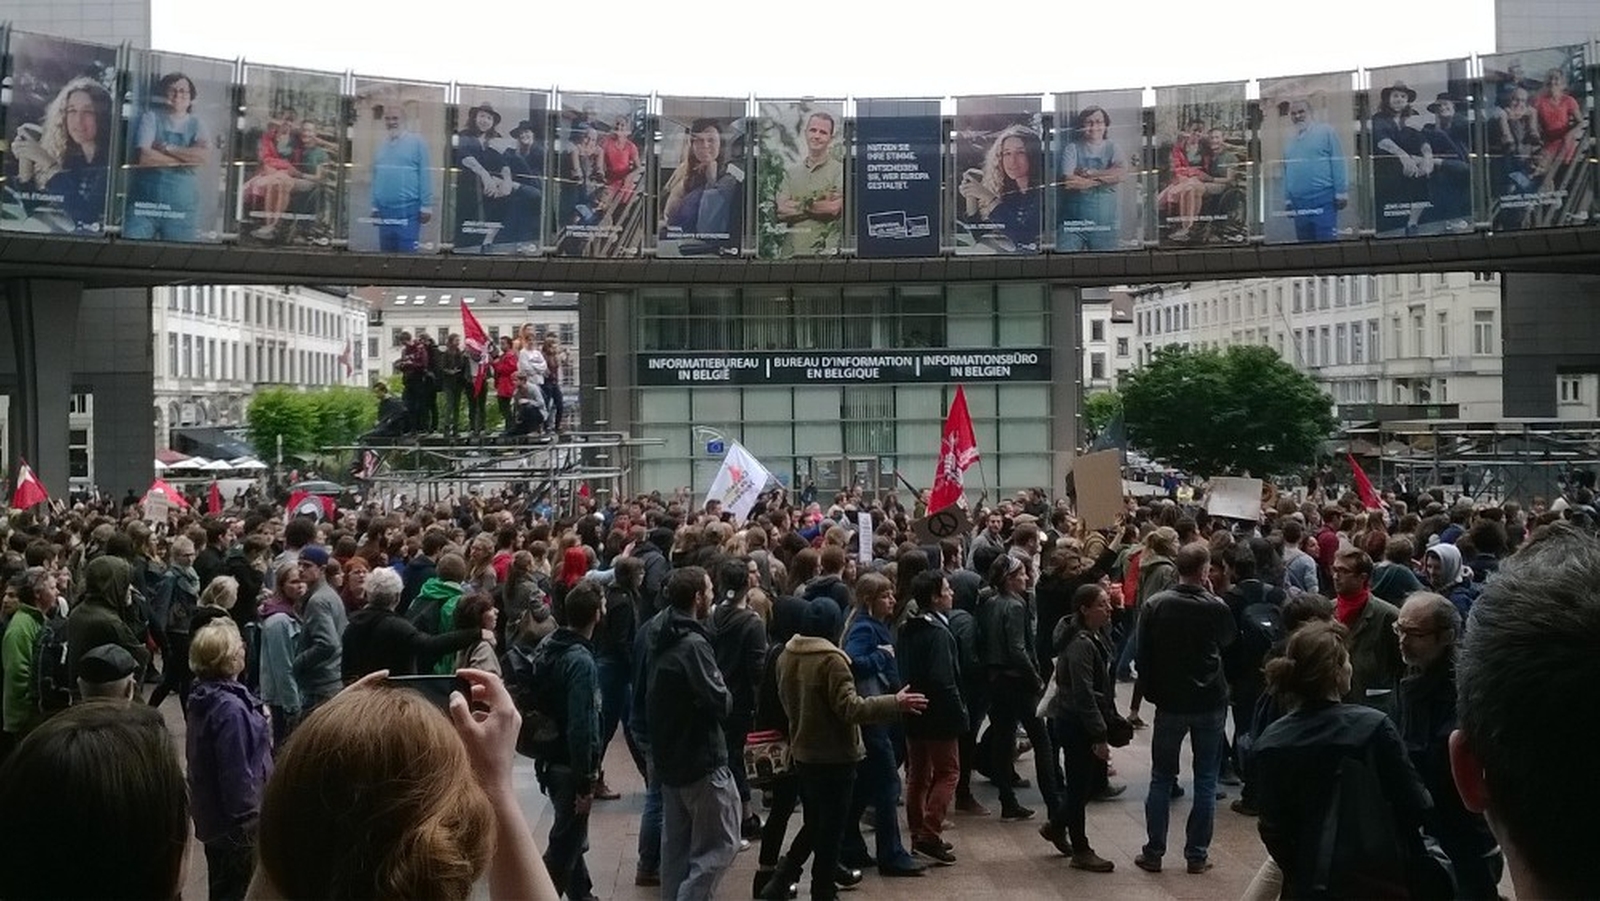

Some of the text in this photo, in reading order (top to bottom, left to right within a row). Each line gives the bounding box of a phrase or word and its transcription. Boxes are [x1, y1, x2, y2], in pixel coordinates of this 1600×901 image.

[648, 357, 759, 369] INFORMATIEBUREAU
[773, 356, 913, 367] BUREAU D'INFORMATION
[922, 352, 1038, 366] INFORMATIONSBÜRO
[677, 367, 731, 380] IN BELGIË
[806, 367, 880, 380] EN BELGIQUE
[950, 365, 1011, 377] IN BELGIEN
